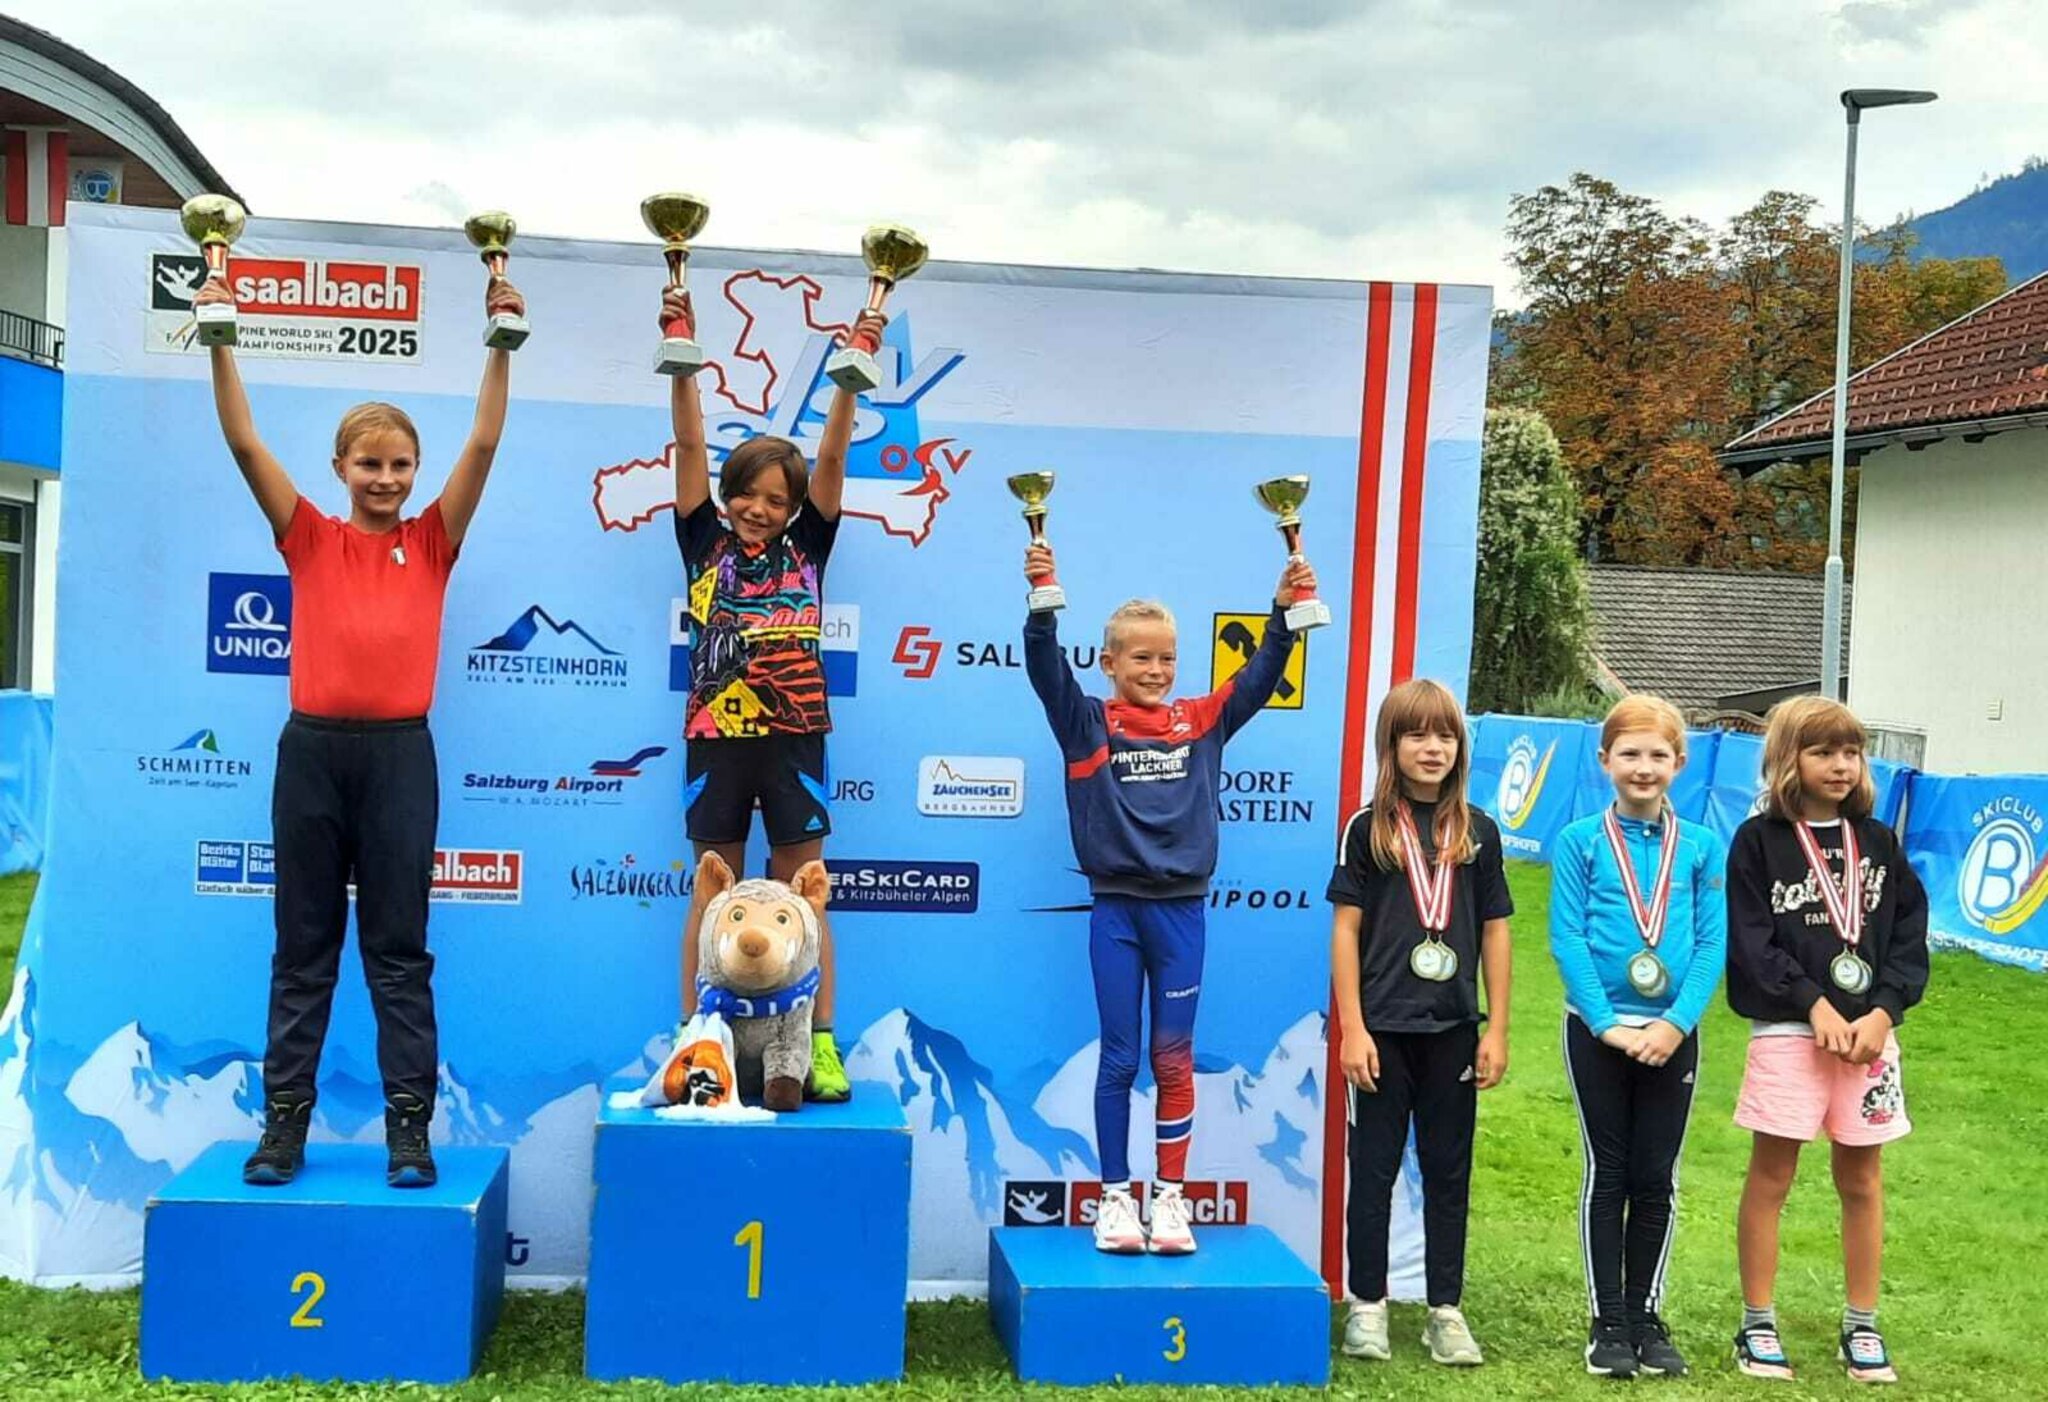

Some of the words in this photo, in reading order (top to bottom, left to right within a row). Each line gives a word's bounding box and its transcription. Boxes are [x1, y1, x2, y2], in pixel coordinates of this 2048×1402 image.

[235, 262, 408, 310] saalbach
[238, 326, 266, 338] PINE
[269, 327, 313, 340] WORLD
[314, 328, 333, 340] SKI
[338, 326, 418, 356] 2025
[467, 654, 627, 677] KITZSTEINHORN
[137, 756, 251, 776] SCHMITTEN
[463, 773, 549, 793] Salzburg
[555, 776, 623, 794] Airport
[1218, 770, 1294, 793] DORF
[1972, 797, 2044, 834] SKICLUB
[200, 843, 240, 857] Bezirks
[432, 852, 512, 883] albach
[850, 888, 928, 902] Kitzbüheler
[932, 890, 970, 903] Alpen
[1210, 890, 1311, 909] IPOOL
[733, 1220, 764, 1301] 1
[289, 1271, 326, 1330] 2
[1162, 1316, 1187, 1362] 3
